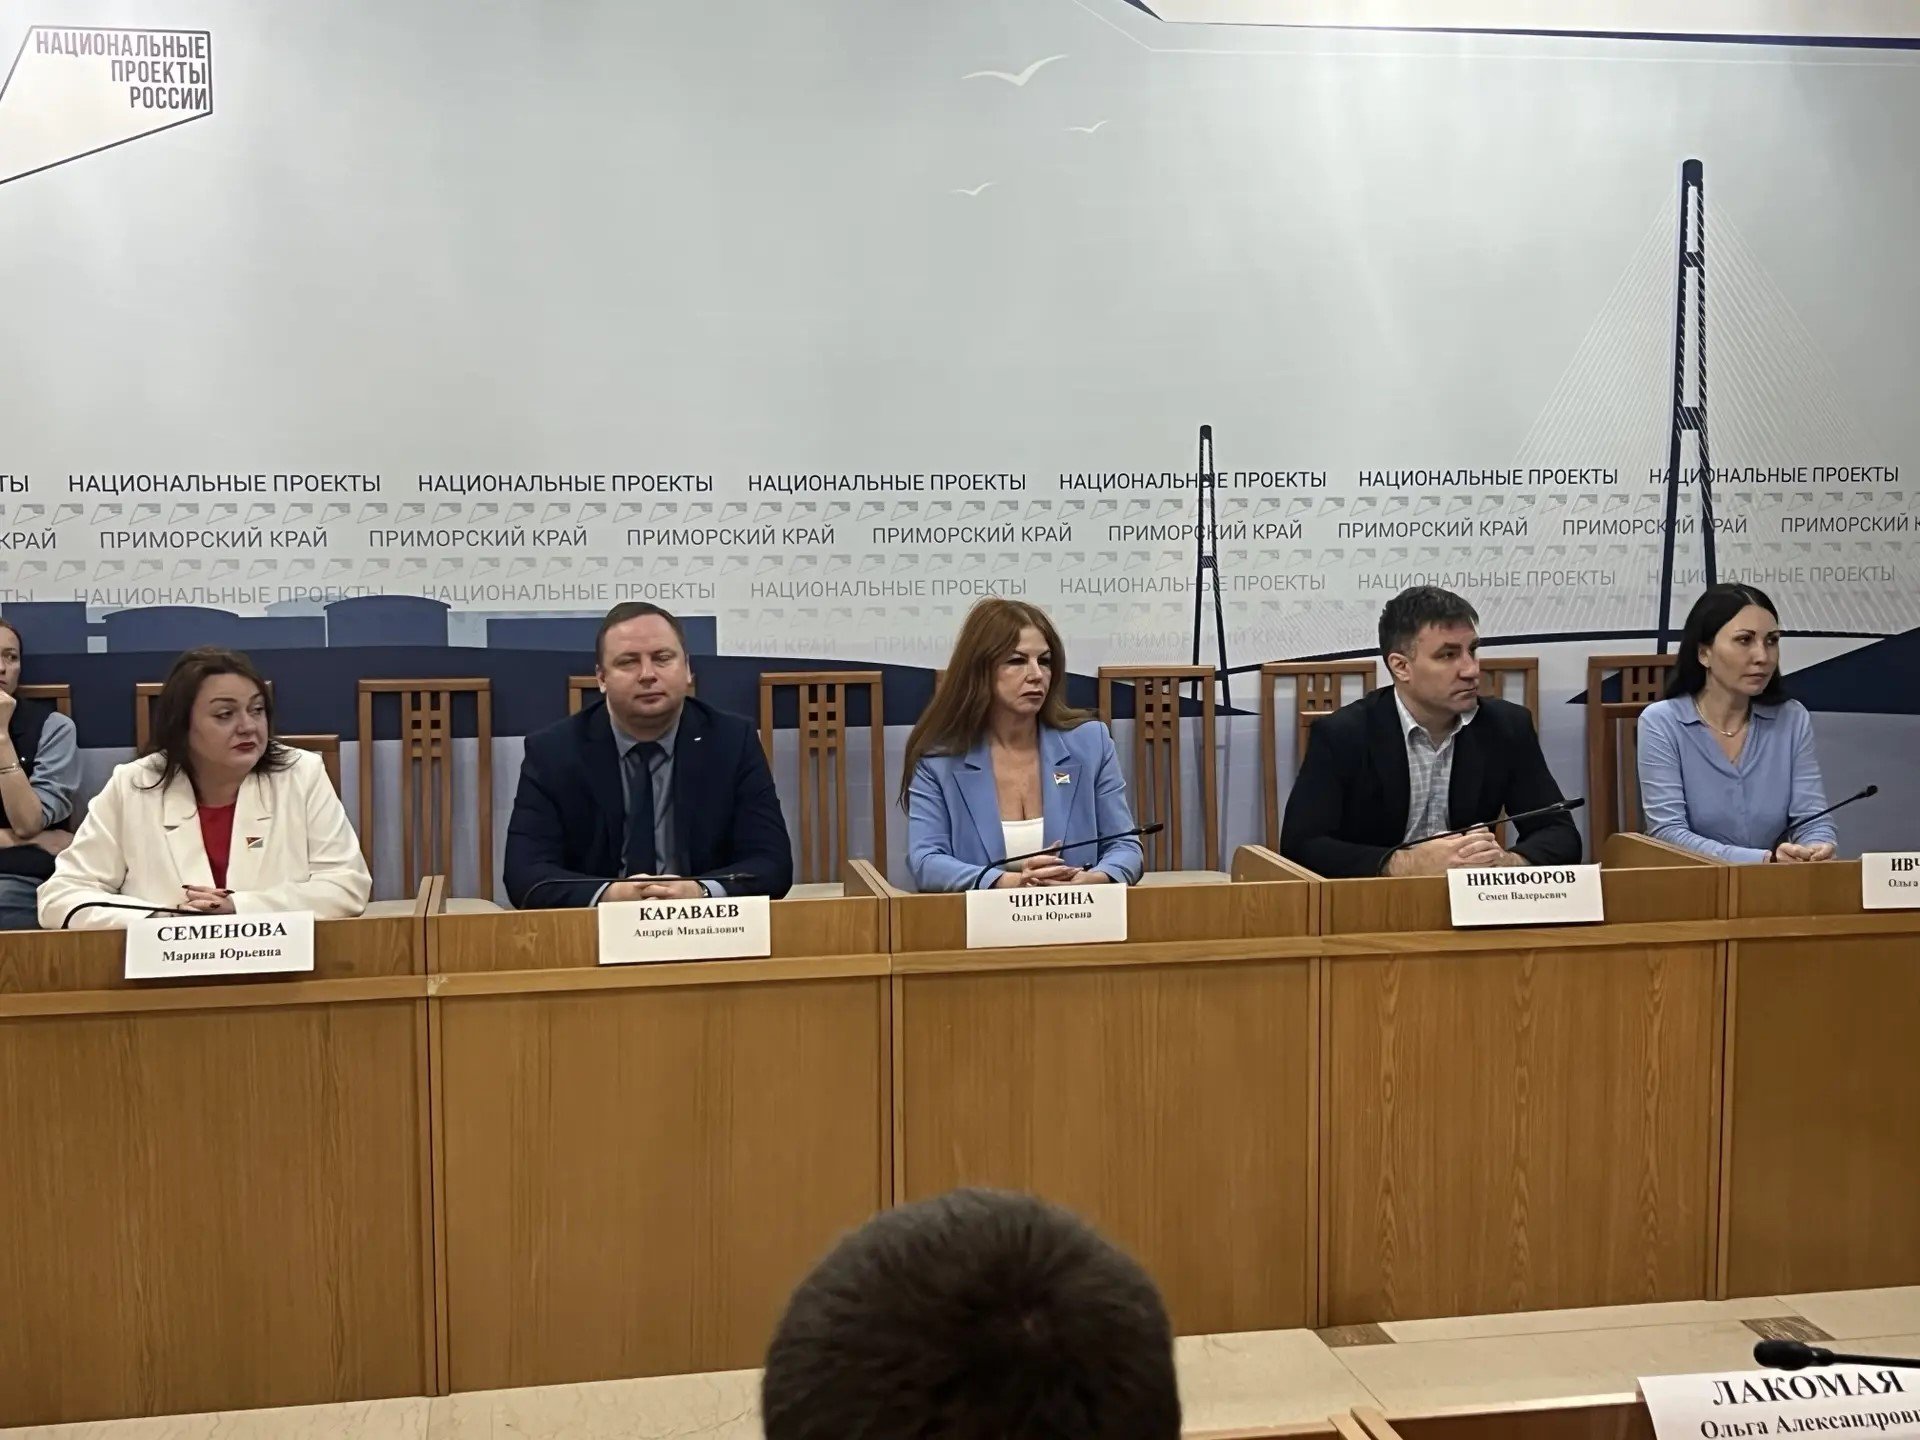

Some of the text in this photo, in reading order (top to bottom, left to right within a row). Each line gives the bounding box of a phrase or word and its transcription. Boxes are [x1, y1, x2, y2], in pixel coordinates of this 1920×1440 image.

[36, 31, 206, 59] НАЦИОНАЛЬНЫЕ
[111, 59, 206, 85] ПРОЕКТЫ
[130, 86, 208, 110] РОССИИ
[748, 474, 1026, 494] НАЦИОНАЛЬНЫЕ ПРОЕКТЫ
[1234, 471, 1326, 488] ПРОЕКТЫ
[1359, 469, 1618, 489] НАЦИОНАЛЬНЫЕ ПРОЕКТЫ
[1812, 466, 1899, 483] ПРОЕКТЫ
[69, 475, 381, 496] НАЦИОНАЛЬНЫЕ ПРОЕКТЫ
[418, 475, 713, 495] НАЦИОНАЛЬНЫЕ ПРОЕКТЫ
[873, 522, 1072, 544] ПРИМОРСКИЙ КРАЙ
[1253, 520, 1302, 540] КРАЙ
[1338, 517, 1528, 539] ПРИМОРСКИЙ КРАЙ
[1701, 514, 1747, 534] РАЙ
[1781, 513, 1909, 533] ПРИМОРСКИЙ
[100, 526, 328, 549] ПРИМОРСКИЙ КРАЙ
[369, 526, 587, 547] ПРИМОРСКИЙ КРАЙ
[627, 524, 835, 546] ПРИМОРСКИЙ КРАЙ
[1233, 574, 1326, 591] ПРОЕКТЫ
[1358, 570, 1616, 592] НАЦИОНАЛЬНЫЕ ПРОЕКТЫ
[1809, 565, 1895, 583] ПРОЕКТЫ
[74, 586, 270, 607] НАЦИОНАЛЬНЫЕ
[422, 583, 715, 604] НАЦИОНАЛЬНЫЕ ПРОЕКТЫ
[751, 579, 1027, 600] НАЦИОНАЛЬНЫЕ ПРОЕКТЫ
[1466, 870, 1576, 887] НИКИФОРОВ
[1009, 891, 1095, 908] ЧИРКИНА
[1478, 891, 1568, 902] Семен Валерьевич
[639, 904, 740, 921] КАРАВАЕВ
[1011, 911, 1092, 923] Ольга Юрьевна
[157, 922, 288, 942] СЕМЕНОВА
[633, 925, 746, 939] Андрей Михайлович
[161, 947, 282, 964] Марина Юрьевна
[1711, 1369, 1907, 1407] ЛАКОМАЯ
[1700, 1419, 1769, 1440] Ольга
